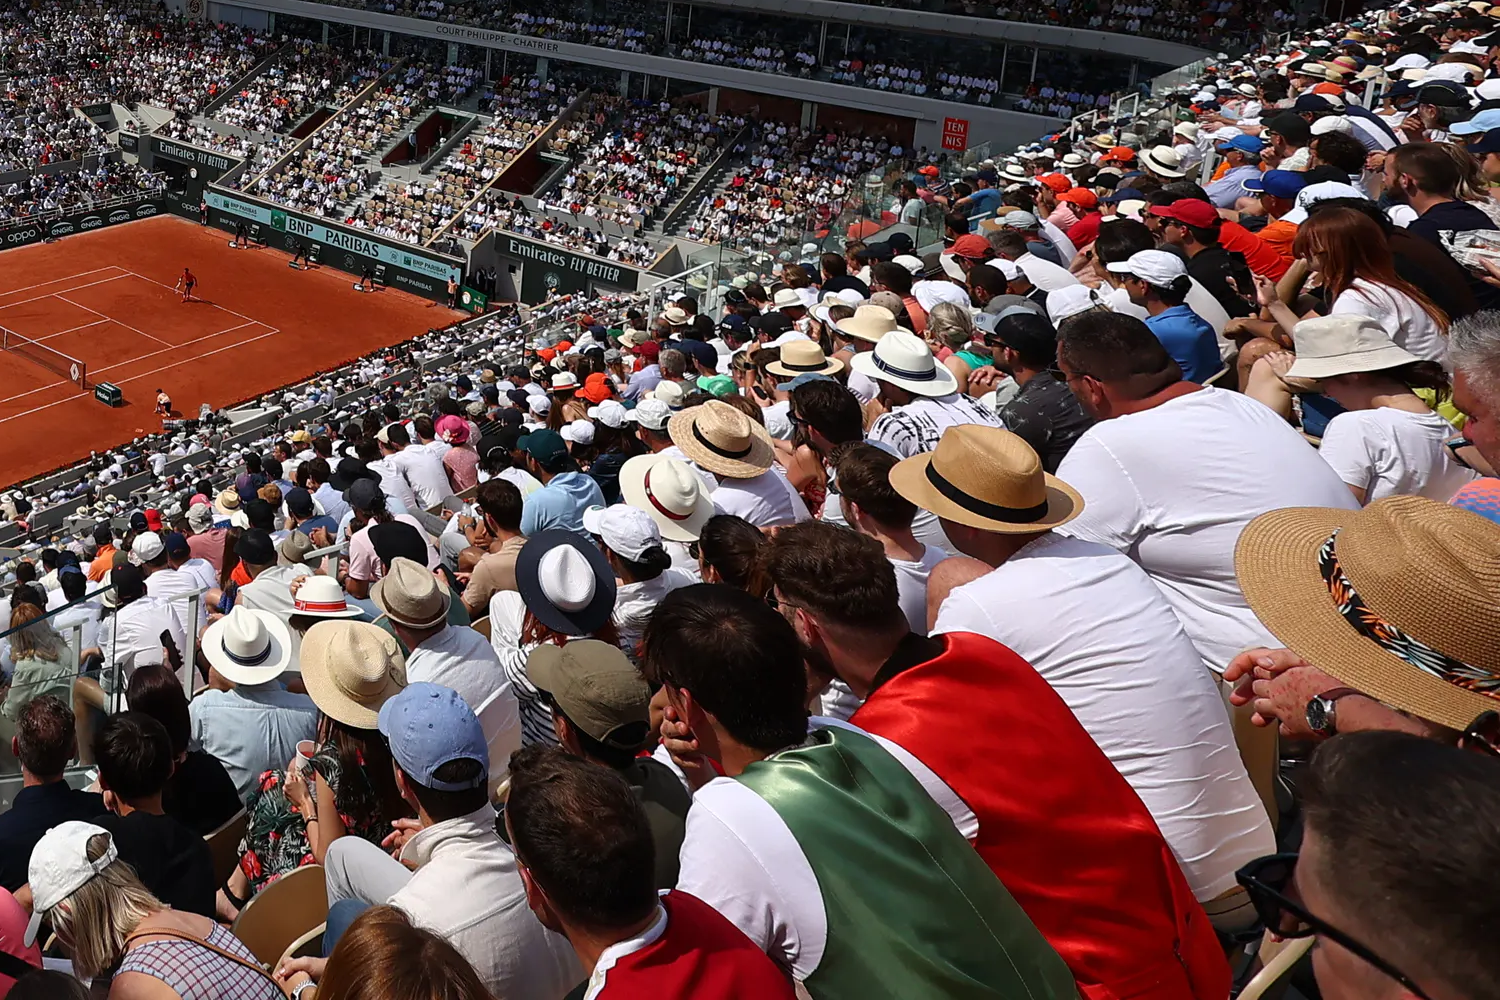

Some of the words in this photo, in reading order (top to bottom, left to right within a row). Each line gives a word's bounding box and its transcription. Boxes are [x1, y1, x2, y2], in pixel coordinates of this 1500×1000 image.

[436, 25, 464, 36] COURT
[467, 30, 505, 43] PHILIPPE
[513, 37, 559, 52] CHATRIER
[947, 121, 964, 133] TEN
[945, 136, 962, 147] NIS
[160, 142, 195, 161] Emirates
[197, 152, 207, 164] FLY
[207, 155, 229, 170] BETTER
[181, 202, 200, 213] oppo
[7, 229, 36, 243] oppo
[289, 218, 314, 236] BNP
[325, 230, 379, 257] PARIBAS
[412, 258, 424, 267] BNP
[424, 262, 447, 274] PARIBAS
[509, 239, 566, 267] Emirates
[570, 257, 585, 272] FLY
[586, 261, 620, 282] BETTER
[396, 275, 408, 284] BNP
[408, 279, 433, 292] PARIBAS
